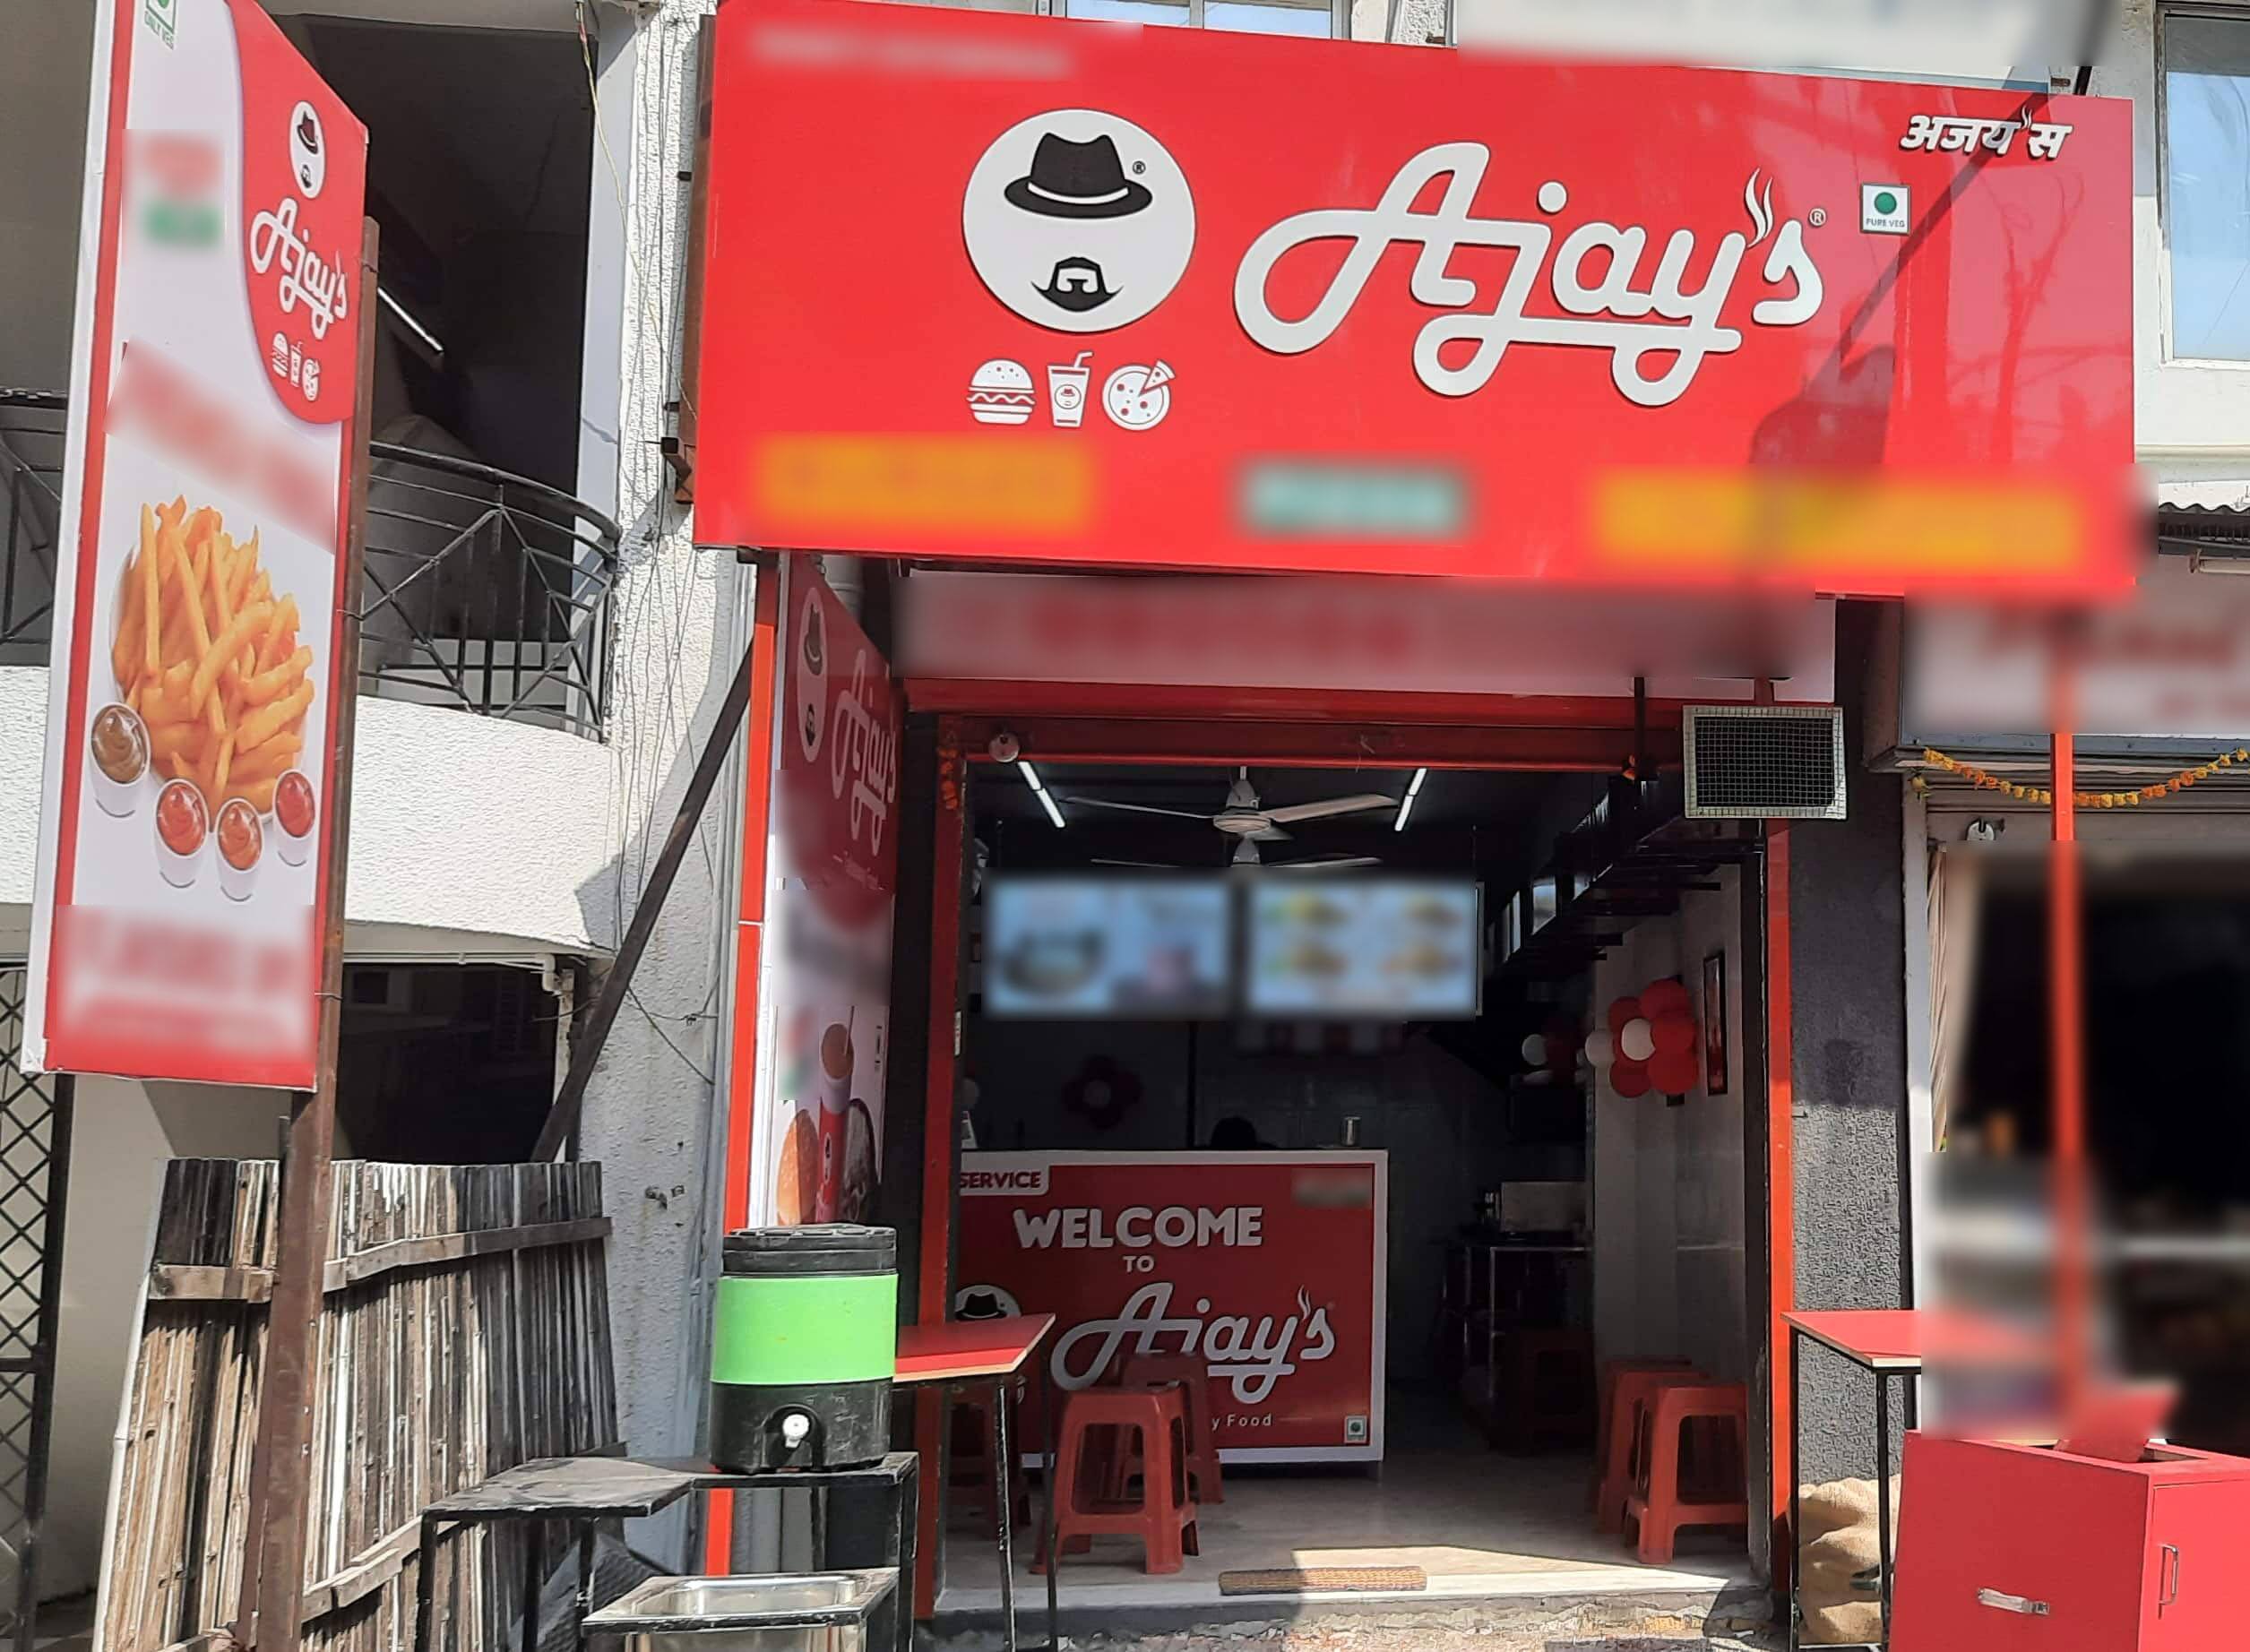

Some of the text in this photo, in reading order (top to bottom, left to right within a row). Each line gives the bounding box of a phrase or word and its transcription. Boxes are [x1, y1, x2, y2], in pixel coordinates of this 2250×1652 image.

[249, 197, 348, 340] Ajay's
[1233, 141, 1824, 407] Ajay's
[960, 1171, 1041, 1189] SERVICE
[1013, 1207, 1263, 1249] WELCOME
[1123, 1255, 1155, 1273] TO
[1227, 1413, 1272, 1427] Food
